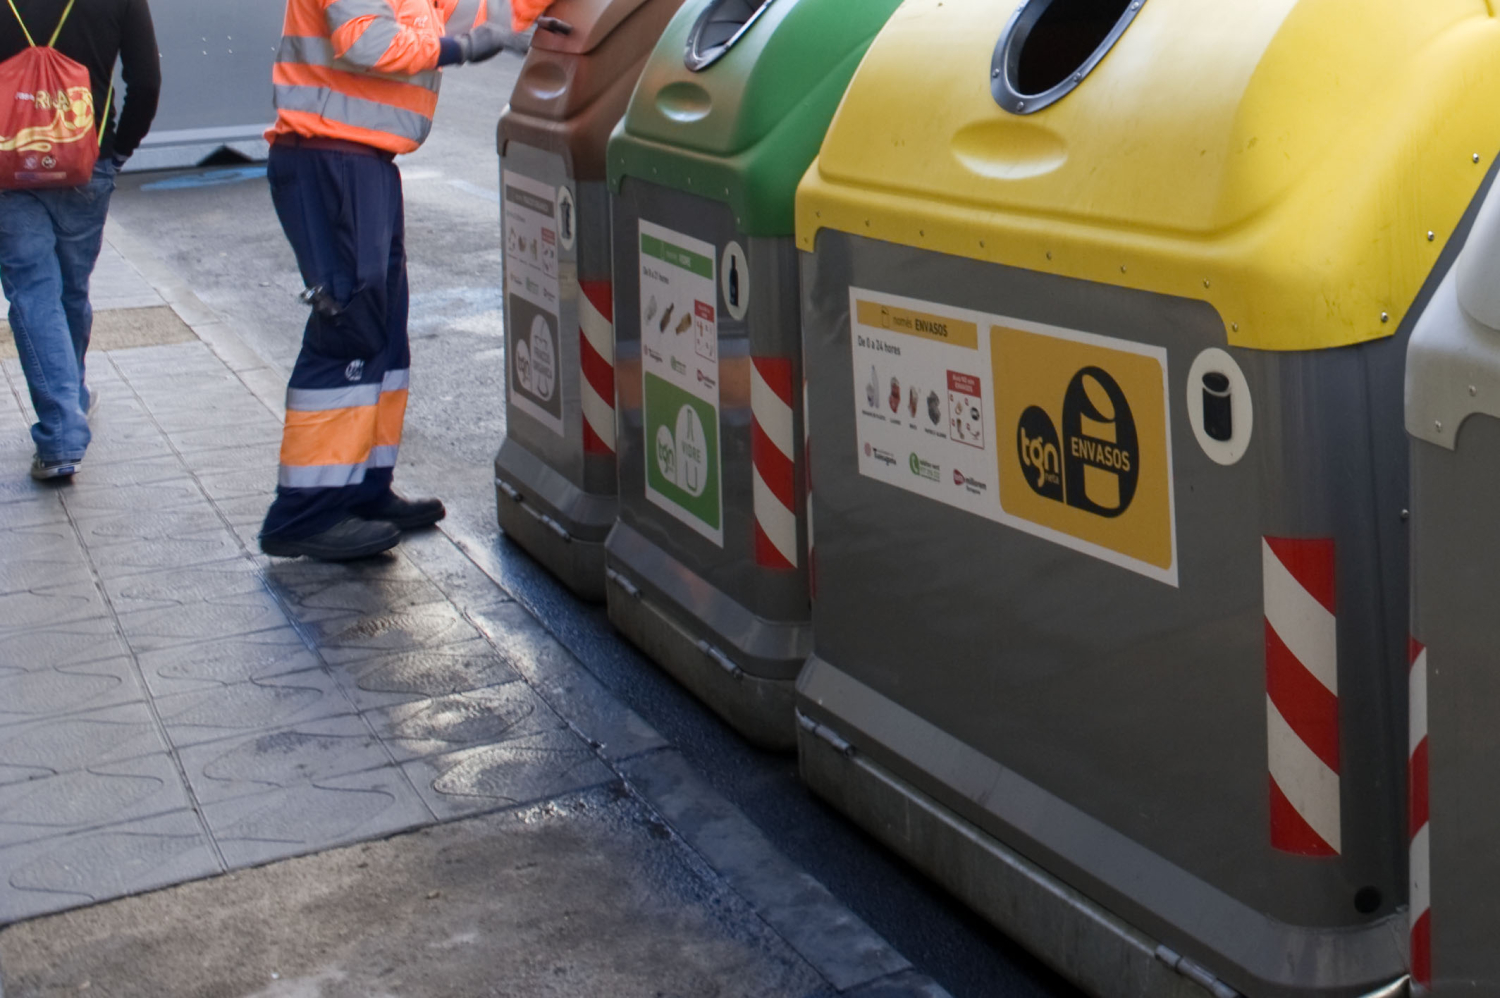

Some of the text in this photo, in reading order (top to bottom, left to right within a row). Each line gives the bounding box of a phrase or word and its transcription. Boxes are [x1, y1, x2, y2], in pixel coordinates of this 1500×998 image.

[915, 318, 948, 337] ENVASOS
[1020, 427, 1059, 487] tgn
[1071, 436, 1130, 472] ENVASOS
